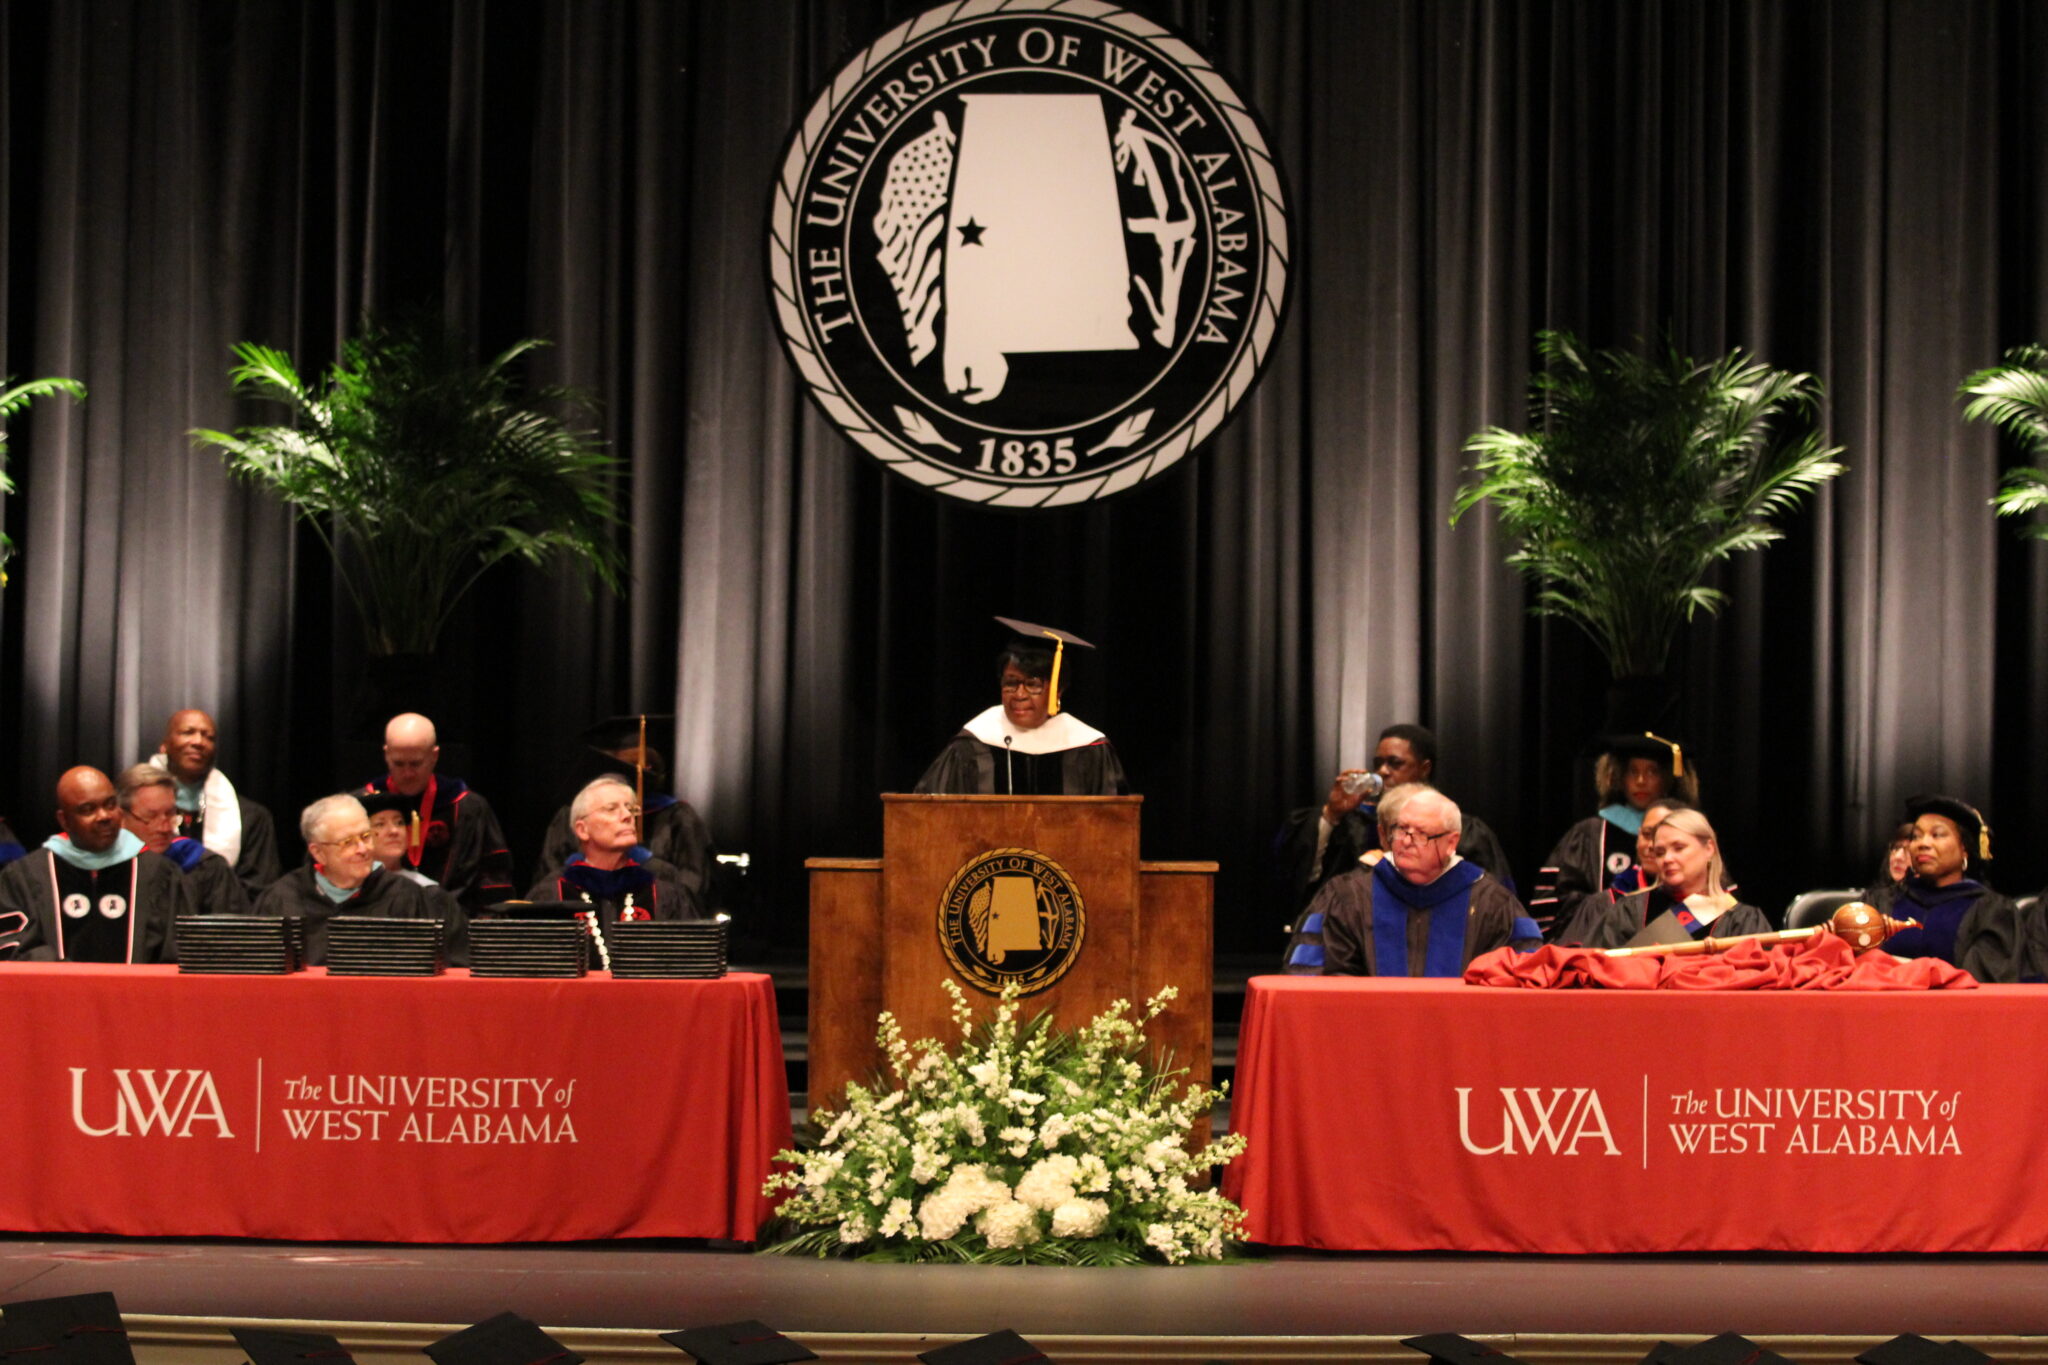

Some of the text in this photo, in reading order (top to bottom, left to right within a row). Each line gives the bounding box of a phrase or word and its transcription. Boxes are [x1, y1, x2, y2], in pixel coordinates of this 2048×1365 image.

[807, 27, 1249, 345] THE UNIVERSITY OF WEST ALABAMA
[974, 437, 1077, 477] 1835
[948, 858, 1075, 950] THE UNIVERSITY OF WEST ALABAMA
[69, 1068, 235, 1138] UWA
[284, 1075, 577, 1109] The UNIVERSITY of
[1671, 1087, 1962, 1121] The UNIVERSITY of
[283, 1108, 578, 1144] WEST ALABAMA
[1455, 1087, 1621, 1156] UWA
[1668, 1122, 1963, 1156] WEST ALABAMA
